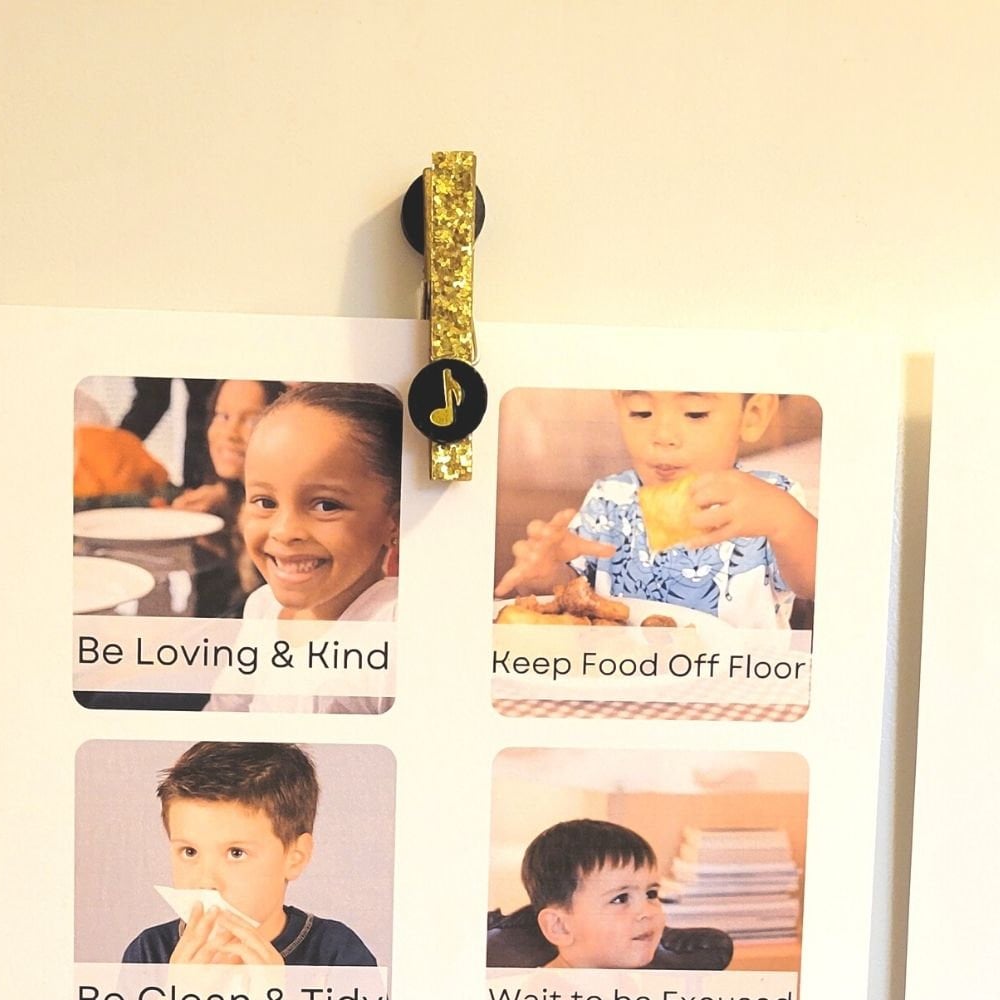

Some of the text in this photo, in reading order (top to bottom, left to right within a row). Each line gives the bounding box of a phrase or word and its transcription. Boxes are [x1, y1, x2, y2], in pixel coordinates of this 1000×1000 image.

[79, 636, 388, 675] Be Loving & Kind
[492, 650, 806, 681] Keep Food Off Floor
